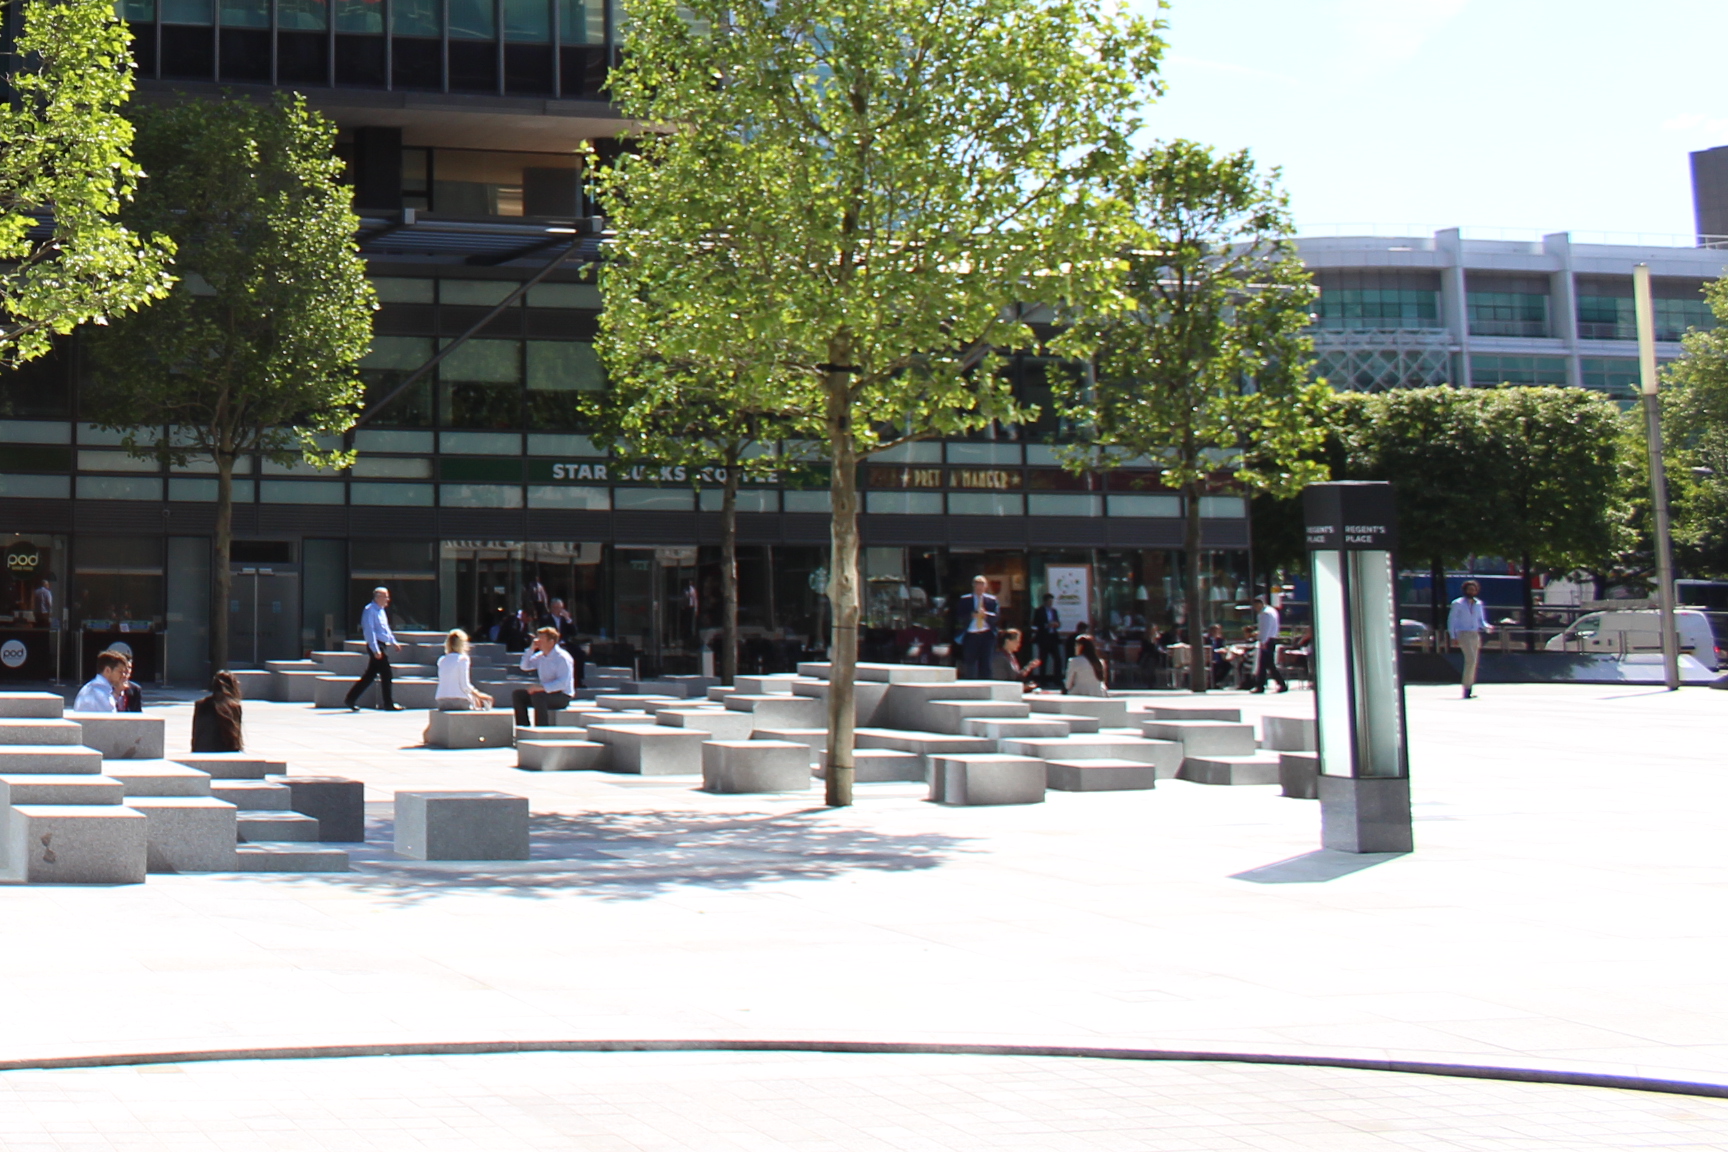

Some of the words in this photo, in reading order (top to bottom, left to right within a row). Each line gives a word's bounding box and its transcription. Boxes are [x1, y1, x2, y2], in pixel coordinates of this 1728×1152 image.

[913, 469, 942, 487] PRET
[962, 470, 1009, 489] MANGER
[1345, 525, 1386, 534] REGENT'S
[1306, 535, 1326, 543] PLACE
[1345, 535, 1373, 543] PLACE
[7, 552, 39, 568] pod
[3, 648, 24, 659] pod
